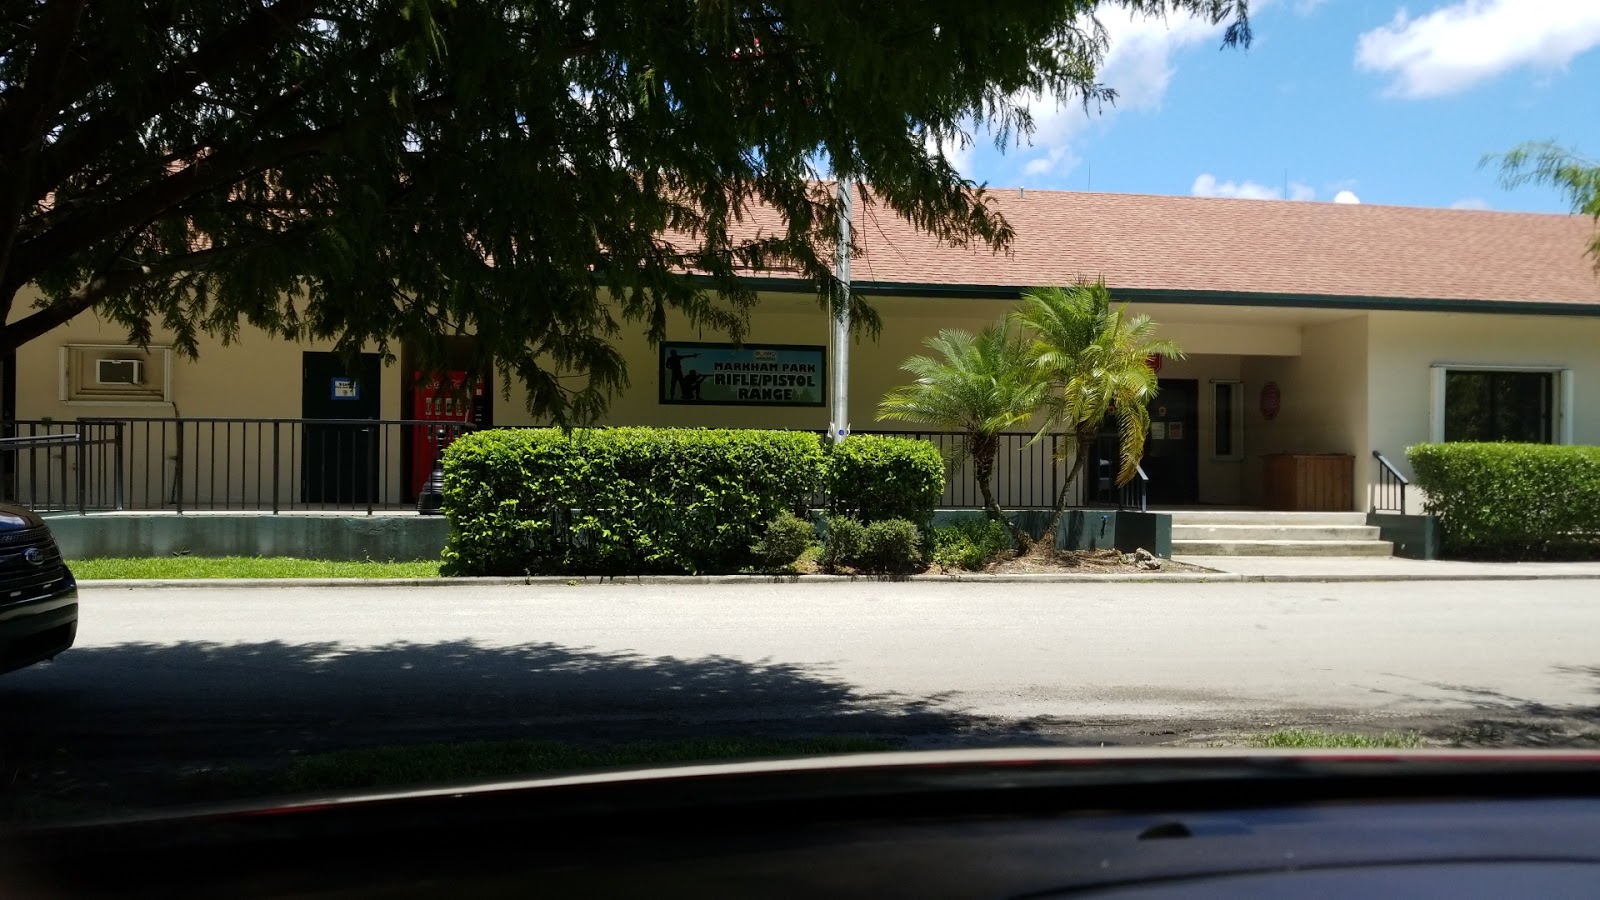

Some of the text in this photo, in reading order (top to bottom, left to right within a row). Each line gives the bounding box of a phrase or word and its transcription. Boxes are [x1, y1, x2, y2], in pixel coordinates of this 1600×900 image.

[714, 362, 816, 373] MARKHAM PARK
[714, 373, 816, 387] RIFLE/PISTOL
[738, 387, 792, 400] RANGE
